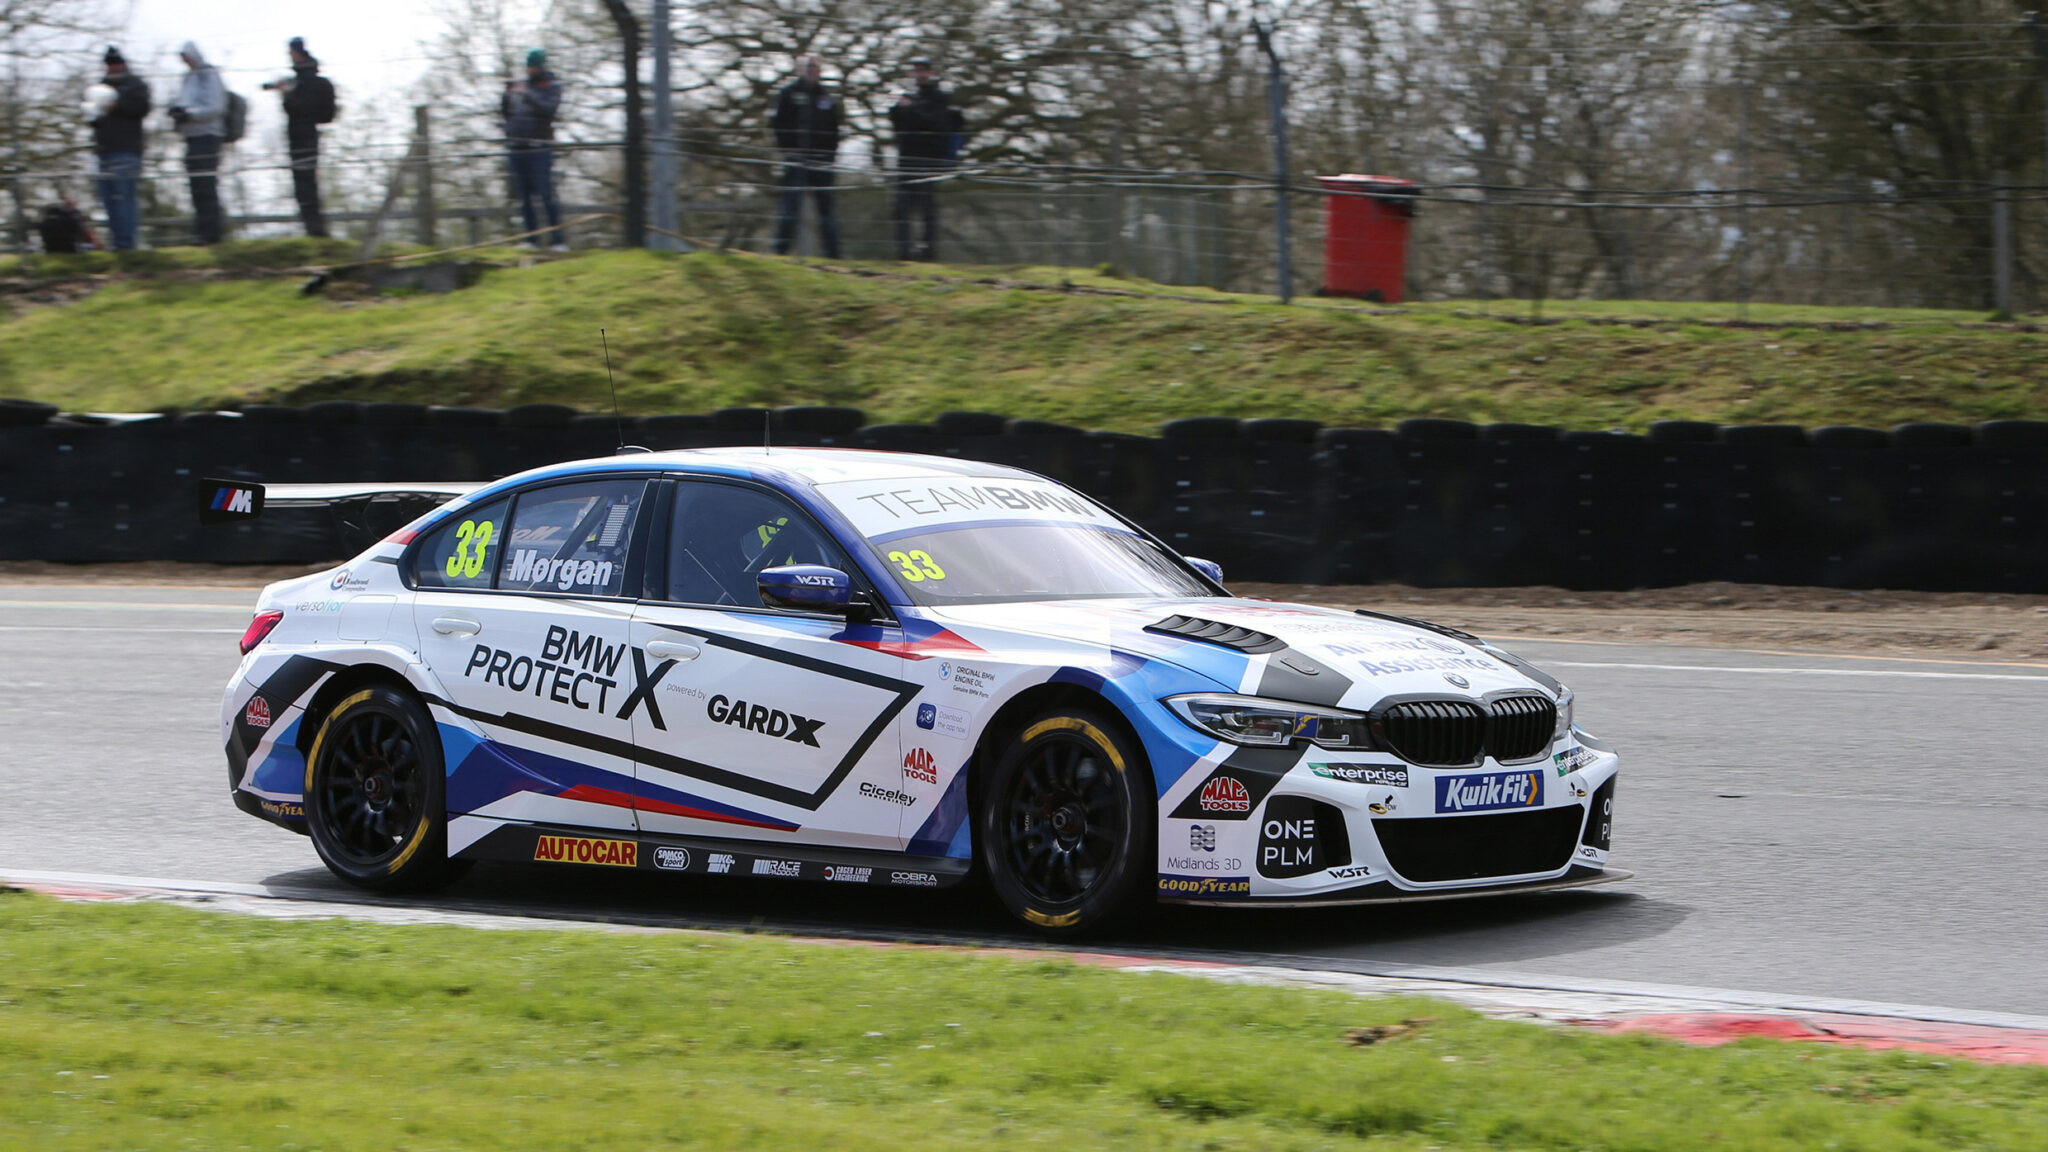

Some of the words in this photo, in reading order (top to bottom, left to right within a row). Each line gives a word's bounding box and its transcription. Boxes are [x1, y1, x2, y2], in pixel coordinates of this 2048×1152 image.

[446, 520, 494, 579] 33
[508, 549, 613, 591] Morgan
[888, 549, 946, 582] 33
[795, 575, 835, 586] WSR
[541, 624, 627, 678] BMW
[957, 666, 981, 678] ORIGINAL
[981, 672, 996, 681] BMW
[1357, 656, 1500, 677] Assistance
[464, 644, 617, 714] PROTECT
[615, 646, 680, 731] X
[955, 675, 974, 686] ENGINE
[247, 696, 269, 718] MAC
[666, 682, 696, 697] powered
[698, 690, 706, 700] by
[707, 694, 826, 748] GARDX
[247, 716, 270, 727] TOOLS
[904, 747, 937, 775] MAC
[904, 768, 937, 785] TOOLS
[1313, 766, 1407, 782] enterprise
[859, 782, 917, 806] Ciceley
[1200, 777, 1249, 801] MAC
[1200, 800, 1249, 811] TOOLS
[1264, 819, 1315, 839] ONE
[1601, 823, 1610, 840] PL
[535, 837, 637, 865] AUTOCAR
[657, 850, 684, 859] SAMCO
[1263, 847, 1313, 866] PLM
[769, 861, 801, 871] RACE
[1167, 857, 1220, 871] Midlands
[1224, 858, 1241, 870] 3D
[1328, 866, 1370, 879] WSR
[768, 869, 800, 877] PADDOCK
[834, 873, 869, 882] ENGINEERING
[890, 871, 937, 882] COBRA
[890, 879, 937, 887] MOTORSPORT
